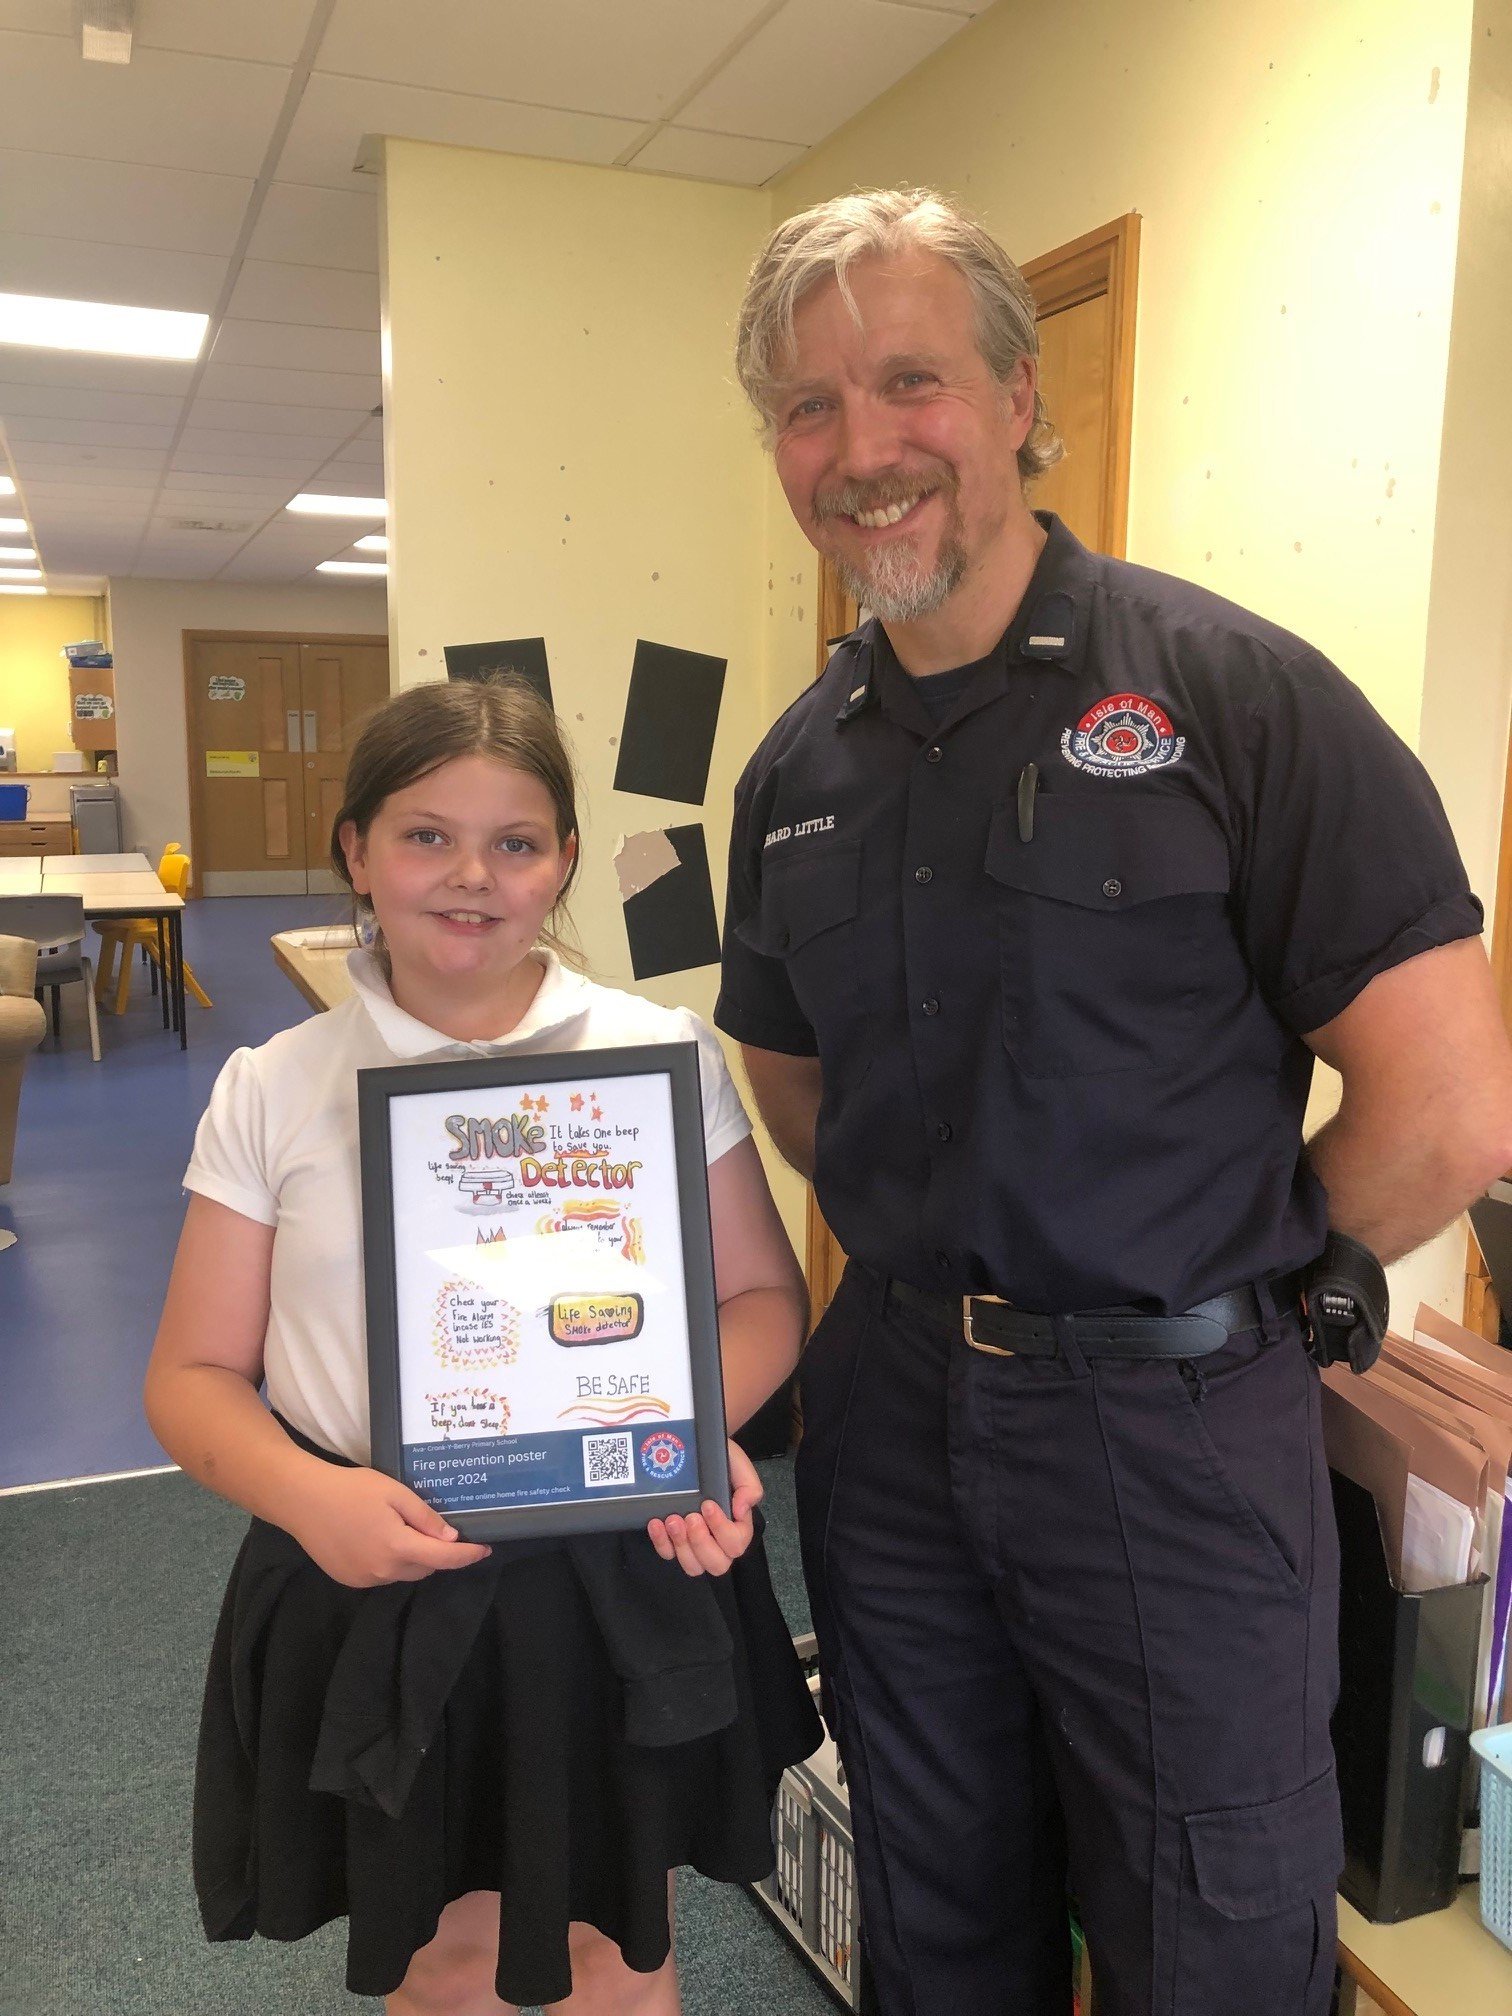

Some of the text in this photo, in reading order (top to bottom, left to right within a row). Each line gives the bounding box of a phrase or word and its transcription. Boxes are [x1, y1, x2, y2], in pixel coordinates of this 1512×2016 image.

[1090, 698, 1162, 725] Isle of Man
[1082, 763, 1147, 778] PROTECTING
[794, 815, 835, 837] LITTLE
[550, 1125, 562, 1140] It
[569, 1124, 590, 1139] takes
[616, 1125, 640, 1141] beep
[553, 1142, 563, 1152] to
[520, 1156, 643, 1190] Detector
[481, 1299, 499, 1313] your
[452, 1309, 467, 1321] Fire
[595, 1319, 631, 1332] detector
[576, 1374, 649, 1397] BE SAFE
[430, 1402, 446, 1416] If
[450, 1403, 467, 1417] you
[472, 1440, 495, 1448] Primary
[496, 1438, 518, 1446] School
[413, 1450, 547, 1472] Fire prevention poster
[413, 1472, 488, 1489] winner 2024
[444, 1497, 459, 1505] your
[461, 1494, 474, 1502] free
[475, 1492, 496, 1500] online
[497, 1490, 515, 1498] home
[529, 1487, 550, 1496] safety
[551, 1485, 571, 1493] check
